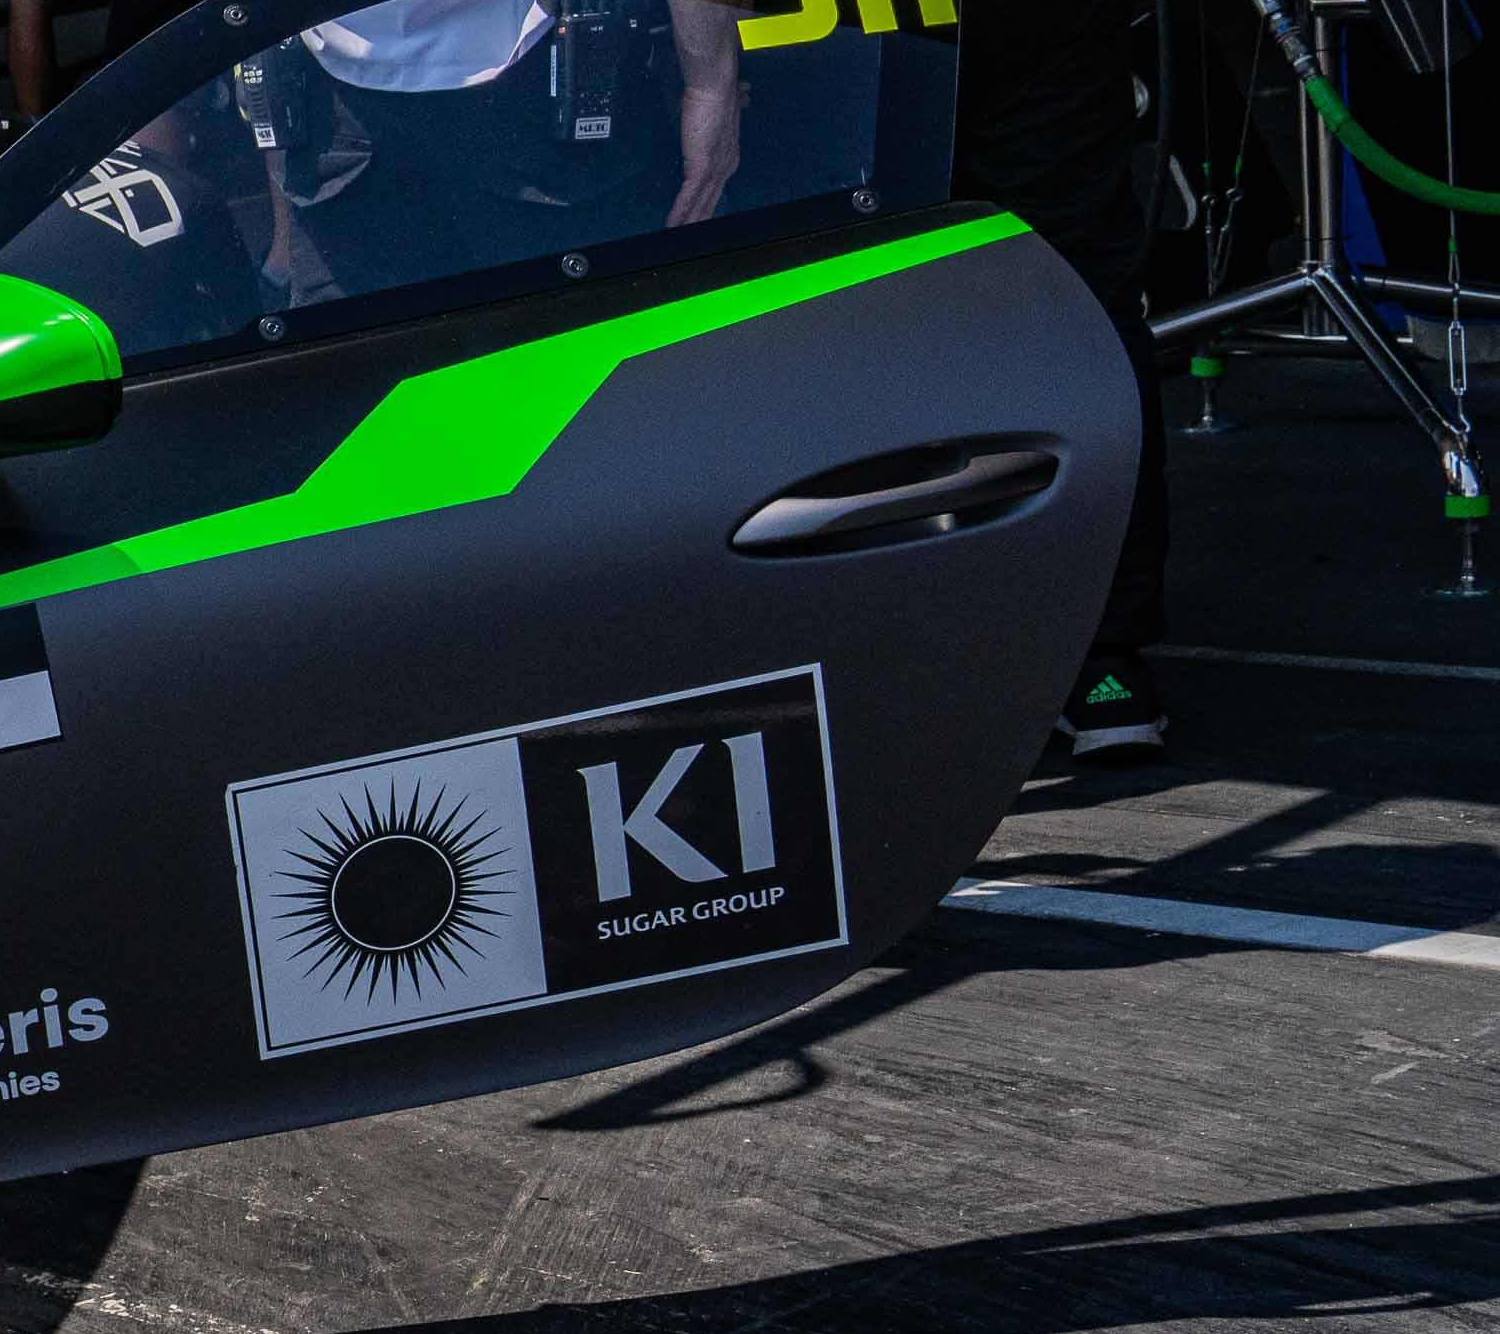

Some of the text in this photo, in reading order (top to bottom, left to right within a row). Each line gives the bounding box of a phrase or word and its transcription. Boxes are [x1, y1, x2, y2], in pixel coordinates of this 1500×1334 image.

[1086, 687, 1132, 705] adidas
[576, 731, 776, 903] KI
[597, 886, 785, 940] SUGAR GROUP
